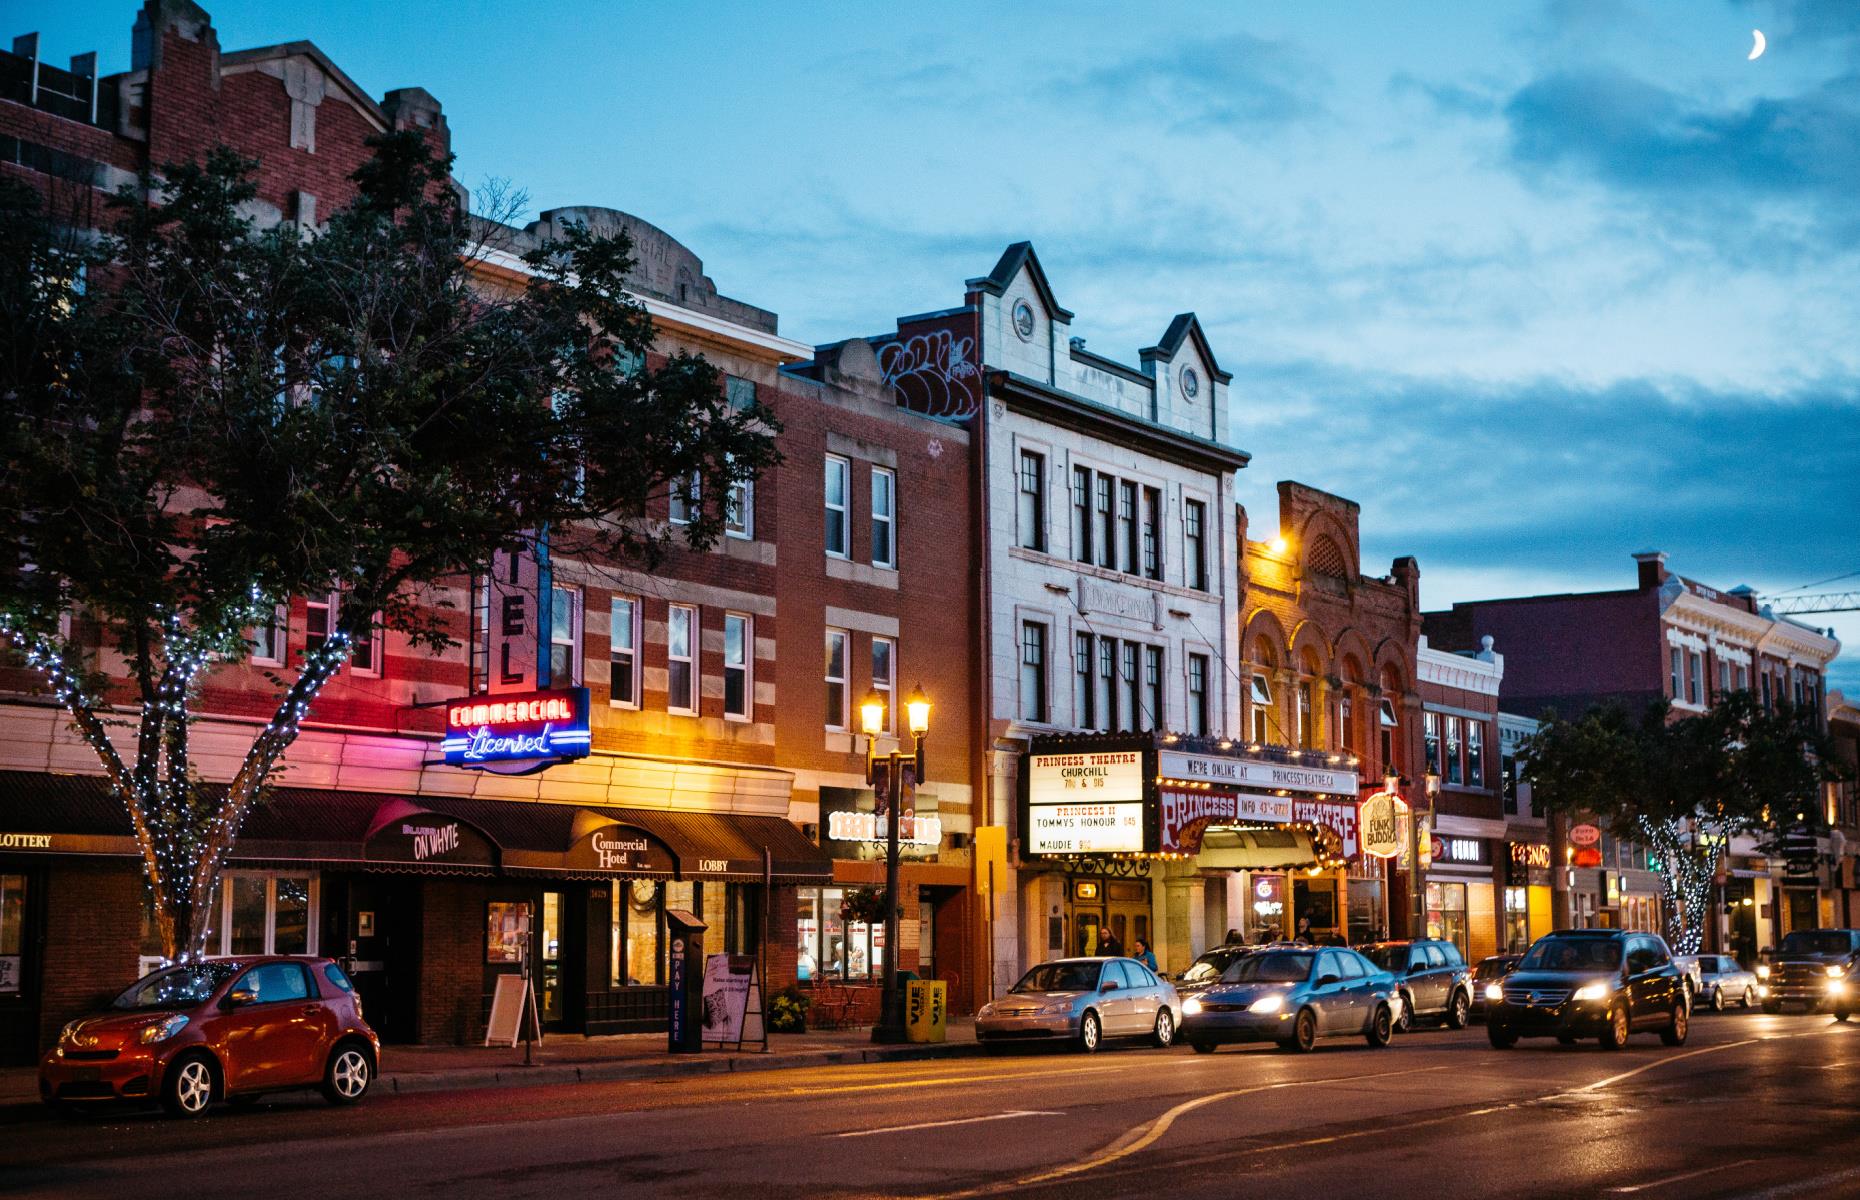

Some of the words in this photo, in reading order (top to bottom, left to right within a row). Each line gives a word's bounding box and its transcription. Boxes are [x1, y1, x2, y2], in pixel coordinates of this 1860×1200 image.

[450, 699, 571, 727] COMMERCIAL
[464, 723, 553, 759] Licensed
[1037, 755, 1085, 767] PRINCESS
[1090, 753, 1136, 765] THEATRE
[1187, 759, 1208, 775] WE'RE
[1212, 763, 1236, 778] ONLINE
[1240, 767, 1248, 780] AT
[1061, 767, 1109, 777] CHURCHILL
[1057, 806, 1105, 817] PRINCESS
[1241, 800, 1256, 814] INFO
[1037, 818, 1075, 829] TOMMYS
[1081, 817, 1116, 827] HONOUR
[1162, 791, 1235, 848] PRINCESS
[1294, 801, 1358, 858] THEATRE
[414, 835, 429, 860] ON
[429, 823, 459, 856] WHYTE
[592, 832, 648, 852] Commercial
[1040, 840, 1072, 850] MAUDIE
[600, 850, 627, 868] Hotel
[699, 859, 728, 872] LOBBY
[911, 986, 921, 1025] VUE
[932, 987, 941, 1026] VUE
[673, 999, 681, 1041] HERE
